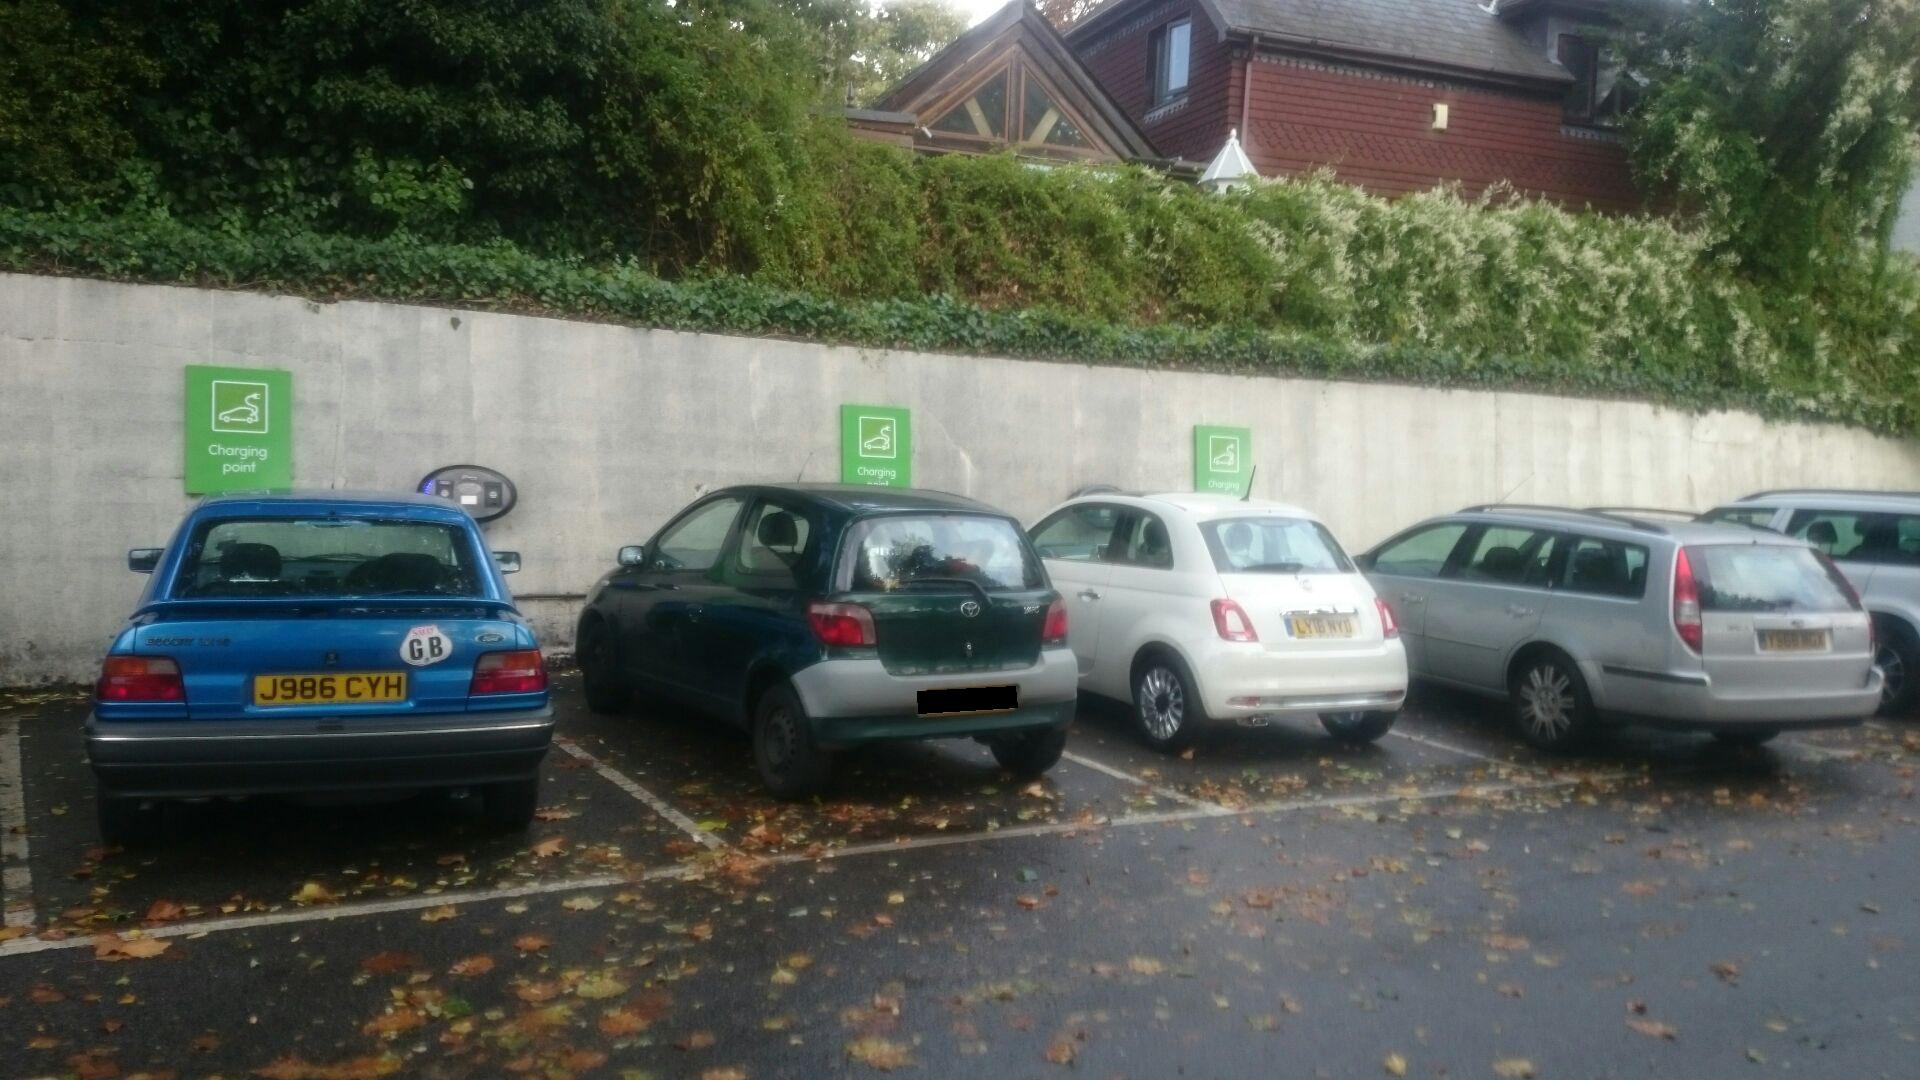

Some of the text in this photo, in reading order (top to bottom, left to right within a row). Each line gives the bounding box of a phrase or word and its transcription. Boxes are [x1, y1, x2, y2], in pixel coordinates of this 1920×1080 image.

[208, 444, 268, 460] Charging
[222, 462, 256, 475] point
[857, 466, 896, 480] Charging
[1208, 480, 1240, 492] Charging
[409, 636, 443, 660] GB
[260, 676, 402, 700] J986 CYH
